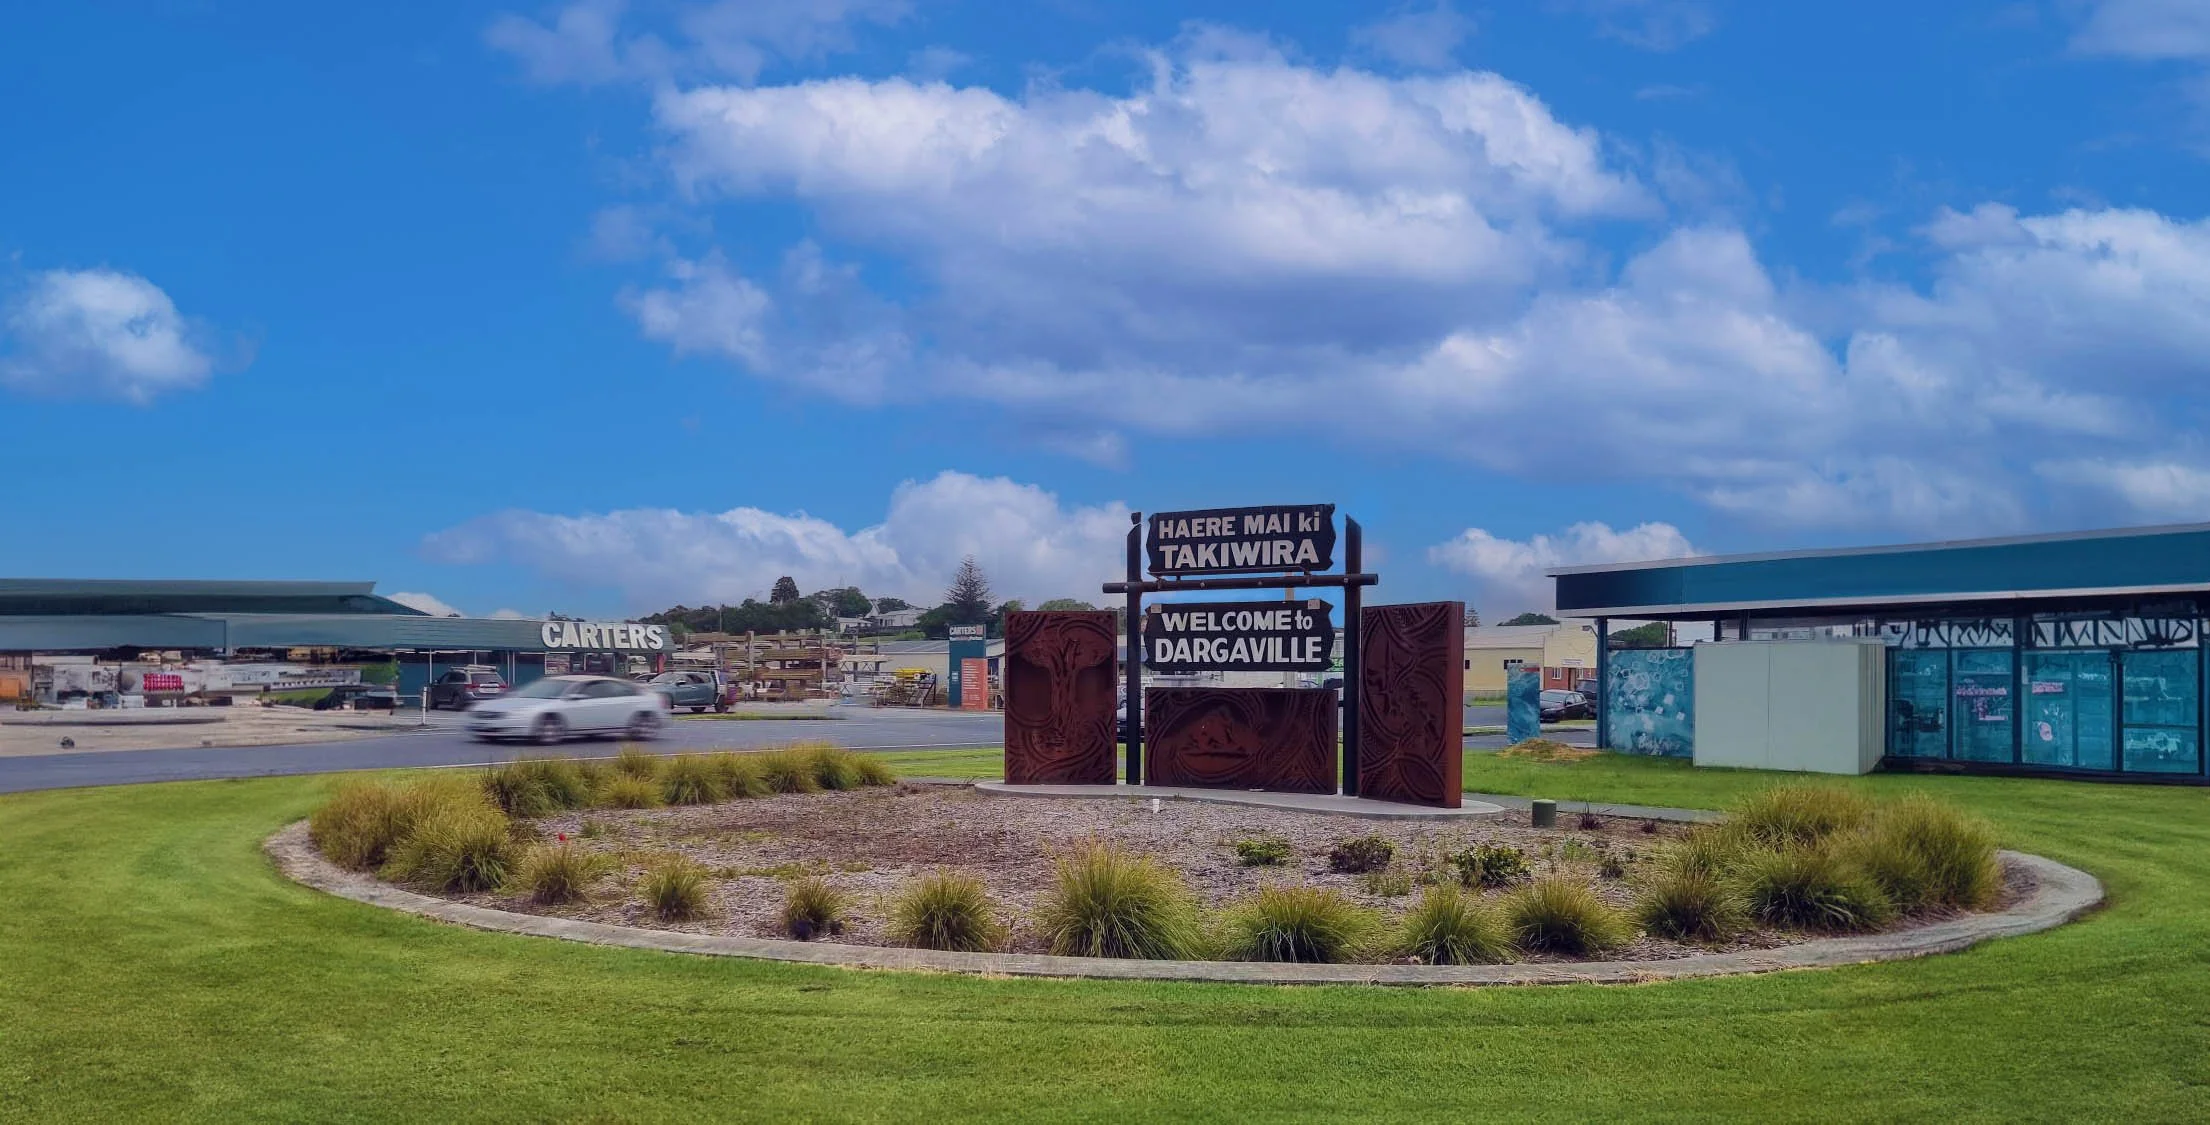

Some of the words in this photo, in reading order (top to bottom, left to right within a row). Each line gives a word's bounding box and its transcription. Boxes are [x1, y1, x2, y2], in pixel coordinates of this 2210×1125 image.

[1159, 516, 1236, 540] HAERE
[1243, 513, 1291, 535] MAI
[1298, 511, 1320, 532] ki
[1159, 538, 1320, 569] TAKIWIRA
[1161, 609, 1292, 632] WELCOME
[1294, 609, 1314, 631] to
[541, 621, 664, 650] CARTERS
[1155, 636, 1322, 663] DARGAVILLE
